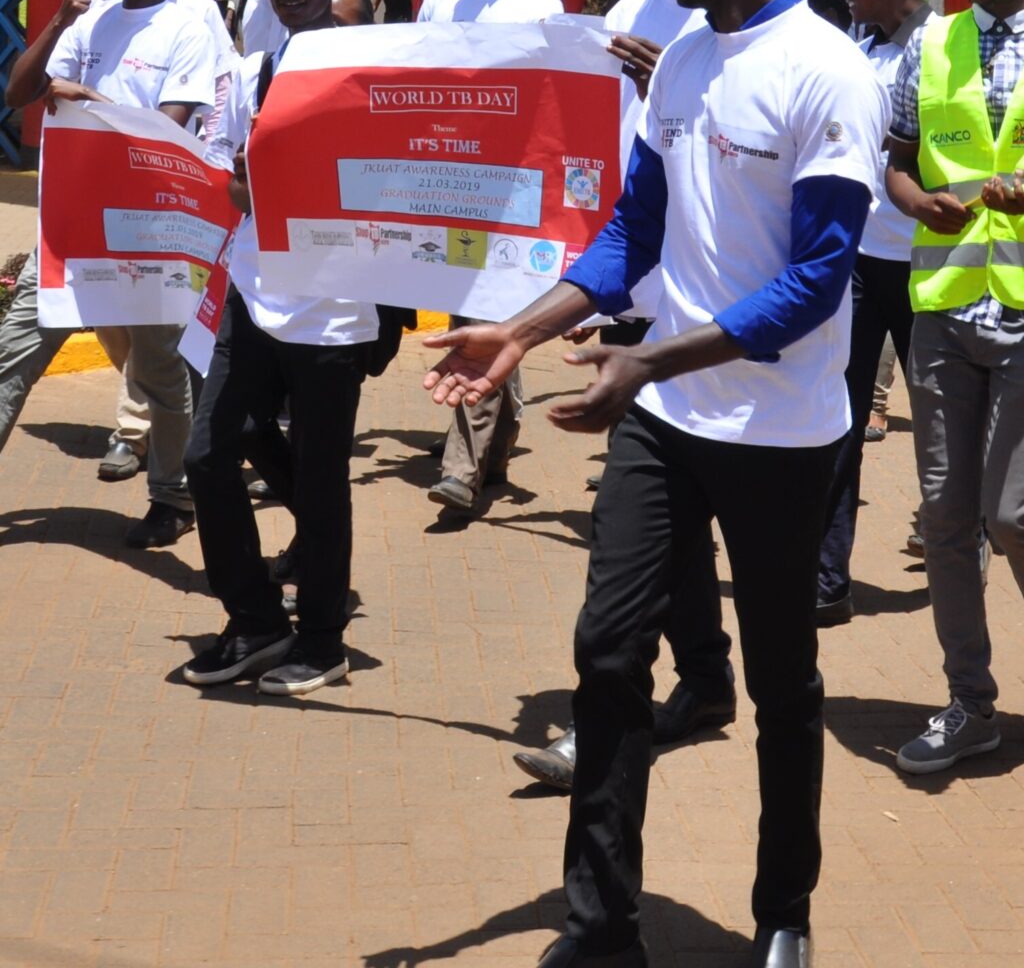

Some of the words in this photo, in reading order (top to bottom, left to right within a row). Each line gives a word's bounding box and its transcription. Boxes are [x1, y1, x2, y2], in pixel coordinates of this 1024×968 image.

[373, 90, 443, 106] WORLD
[447, 91, 473, 105] TB
[477, 92, 514, 107] DAY
[432, 124, 457, 133] Theme
[666, 128, 683, 138] END
[665, 138, 674, 148] TB
[930, 130, 971, 144] KANCO
[409, 138, 439, 152] IT'S
[444, 139, 481, 154] TIME
[729, 141, 779, 161] Partnership
[131, 151, 173, 169] WORLD
[173, 159, 188, 172] TB
[562, 155, 591, 168] UNITE
[592, 159, 605, 170] TO
[361, 163, 400, 175] JKUAT
[403, 164, 471, 178] AWARENESS
[474, 169, 532, 184] CAMPAIGN
[418, 178, 480, 192] 21.03.2019
[155, 192, 177, 205] IT'S
[380, 189, 459, 204] GRADUATION
[462, 194, 516, 209] GROUNDS
[409, 202, 442, 214] MAIN
[444, 204, 488, 218] CAMPUS
